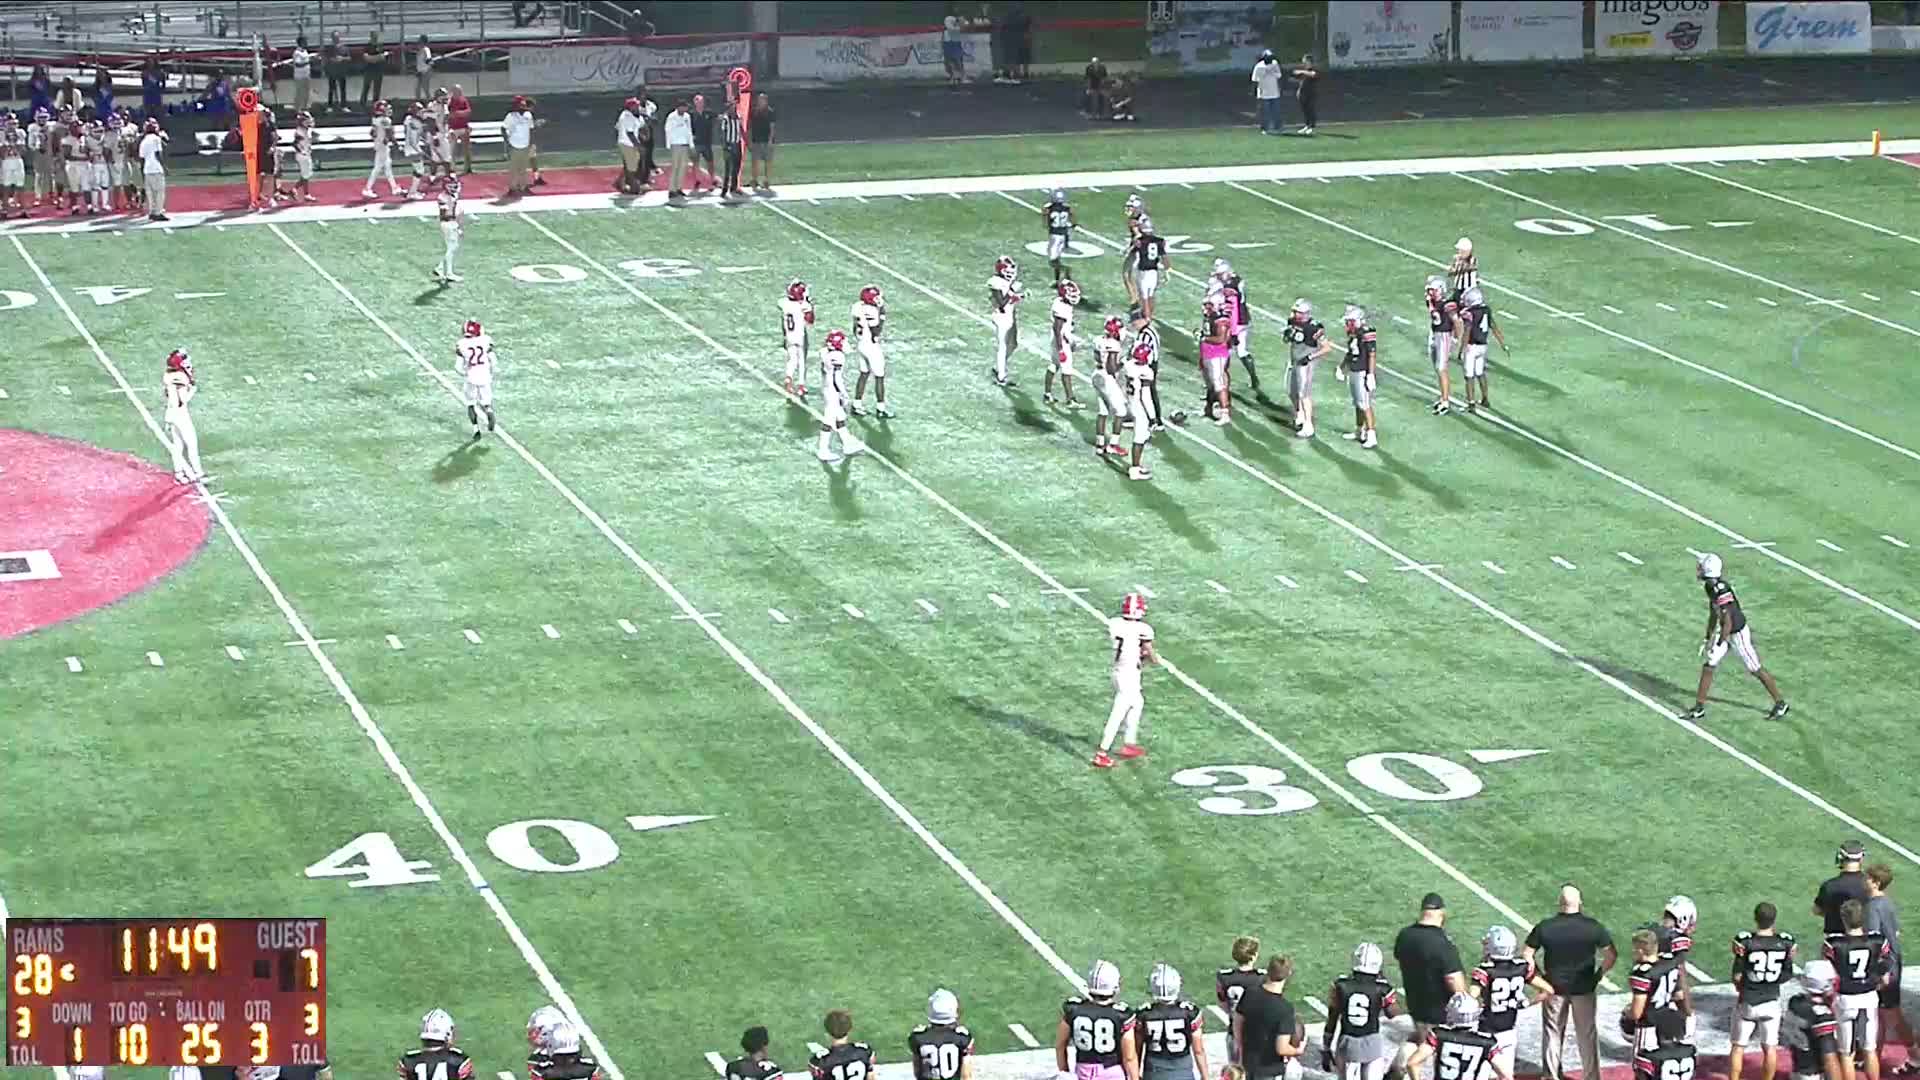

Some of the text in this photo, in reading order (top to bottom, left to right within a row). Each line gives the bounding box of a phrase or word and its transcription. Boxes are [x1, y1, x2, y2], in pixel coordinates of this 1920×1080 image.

[467, 346, 485, 367] 22
[1848, 949, 1870, 979] 7
[1347, 992, 1370, 1027] 6
[1071, 1015, 1116, 1053] 68
[1146, 1018, 1186, 1053] 75
[1440, 1041, 1483, 1080] 57
